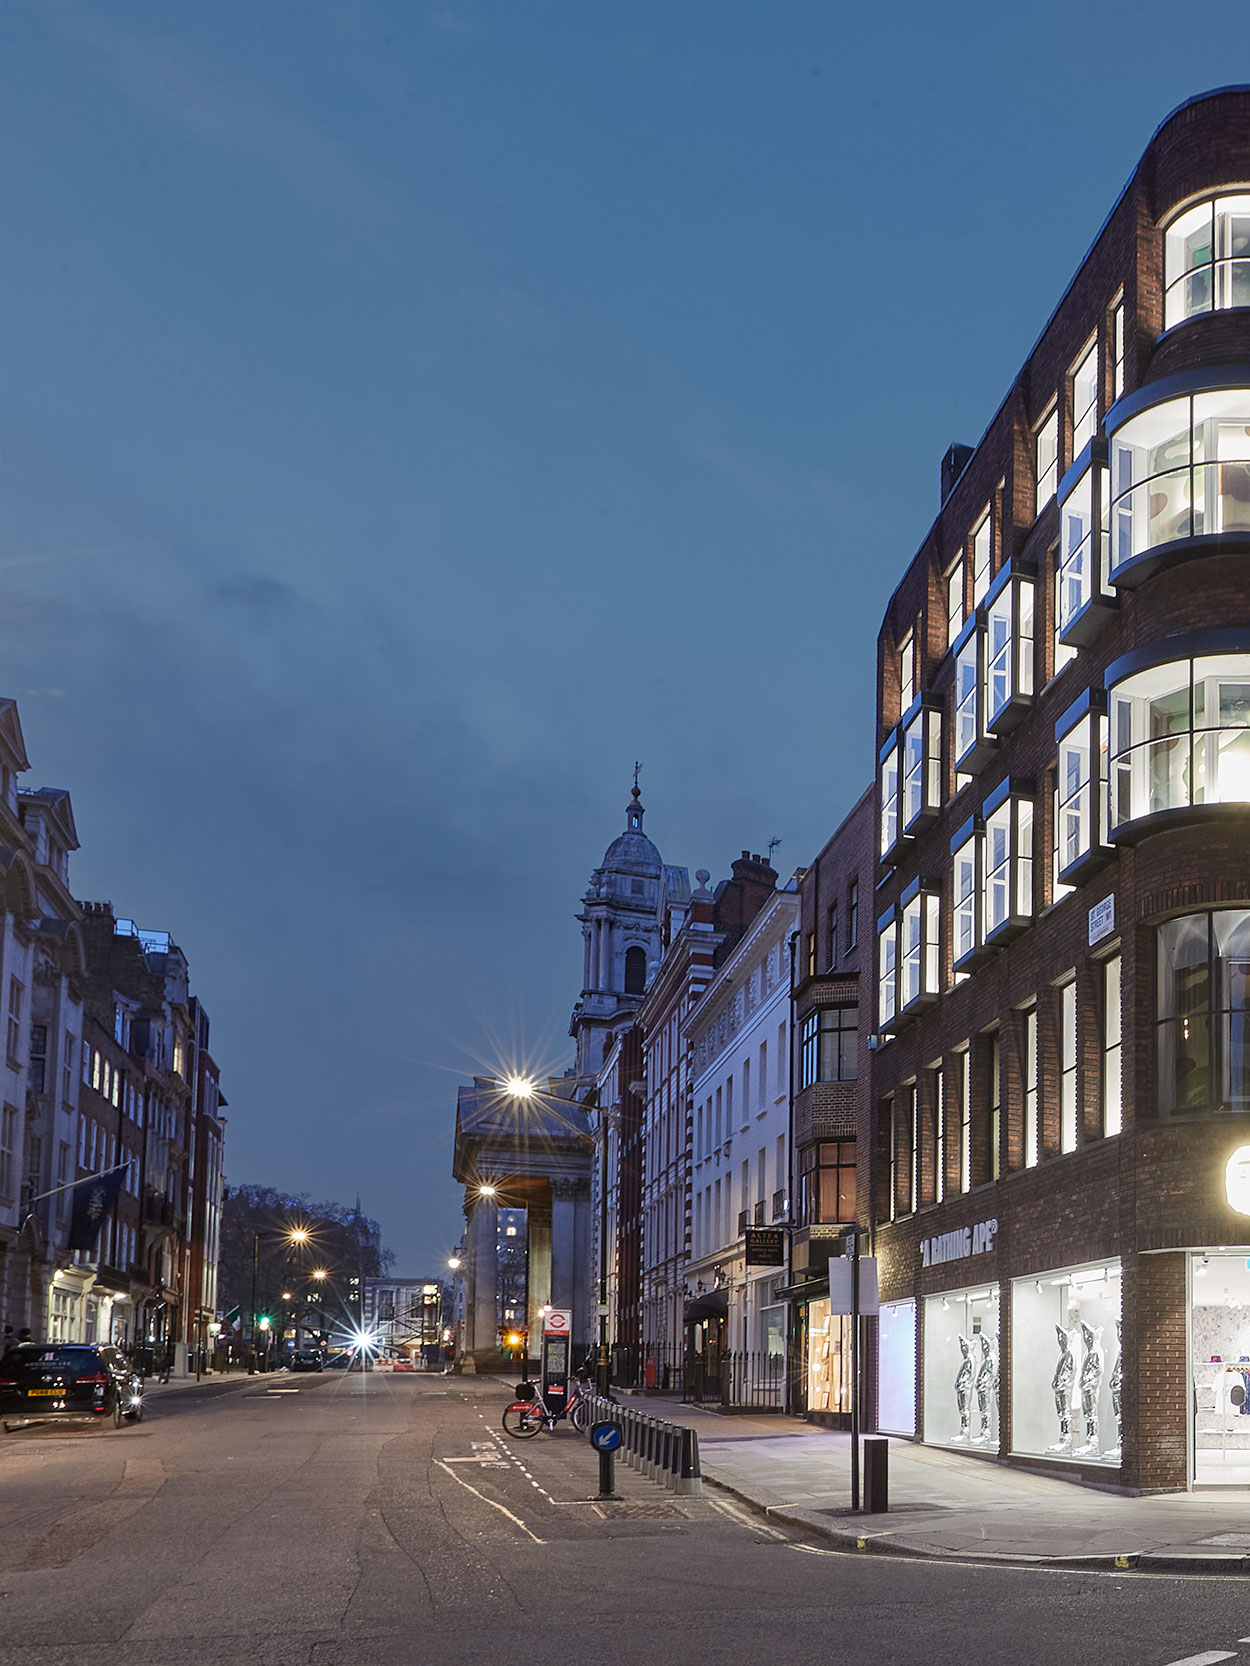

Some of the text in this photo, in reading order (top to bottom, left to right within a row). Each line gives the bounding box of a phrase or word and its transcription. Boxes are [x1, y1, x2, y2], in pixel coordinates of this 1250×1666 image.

[1097, 899, 1112, 917] GEORGE
[1091, 915, 1104, 932] STREET
[931, 1226, 972, 1266] BATHING
